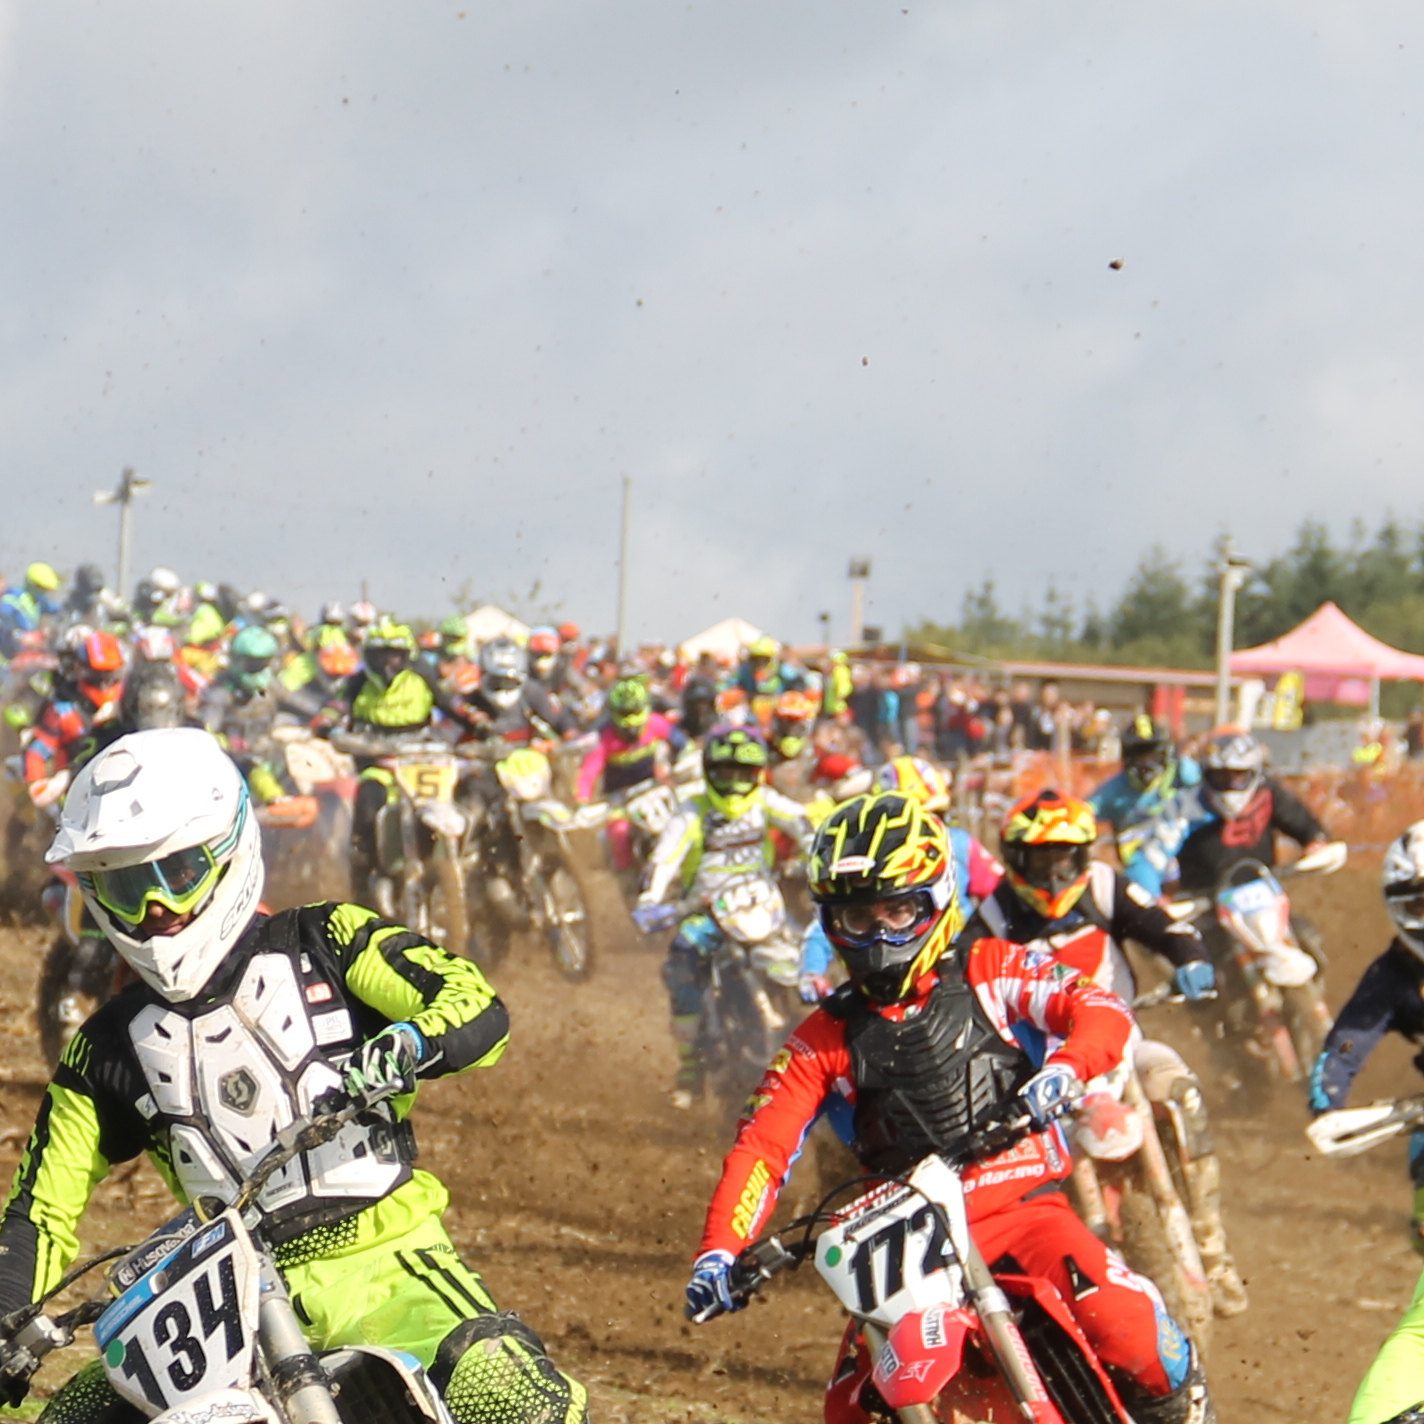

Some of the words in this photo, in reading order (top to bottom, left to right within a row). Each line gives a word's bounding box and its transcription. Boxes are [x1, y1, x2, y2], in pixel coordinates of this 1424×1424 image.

[978, 1162, 1046, 1188] Racing
[132, 1220, 197, 1275] Husqvana
[192, 1222, 226, 1258] FFM
[848, 1201, 958, 1314] 172
[122, 1253, 245, 1410] 134
